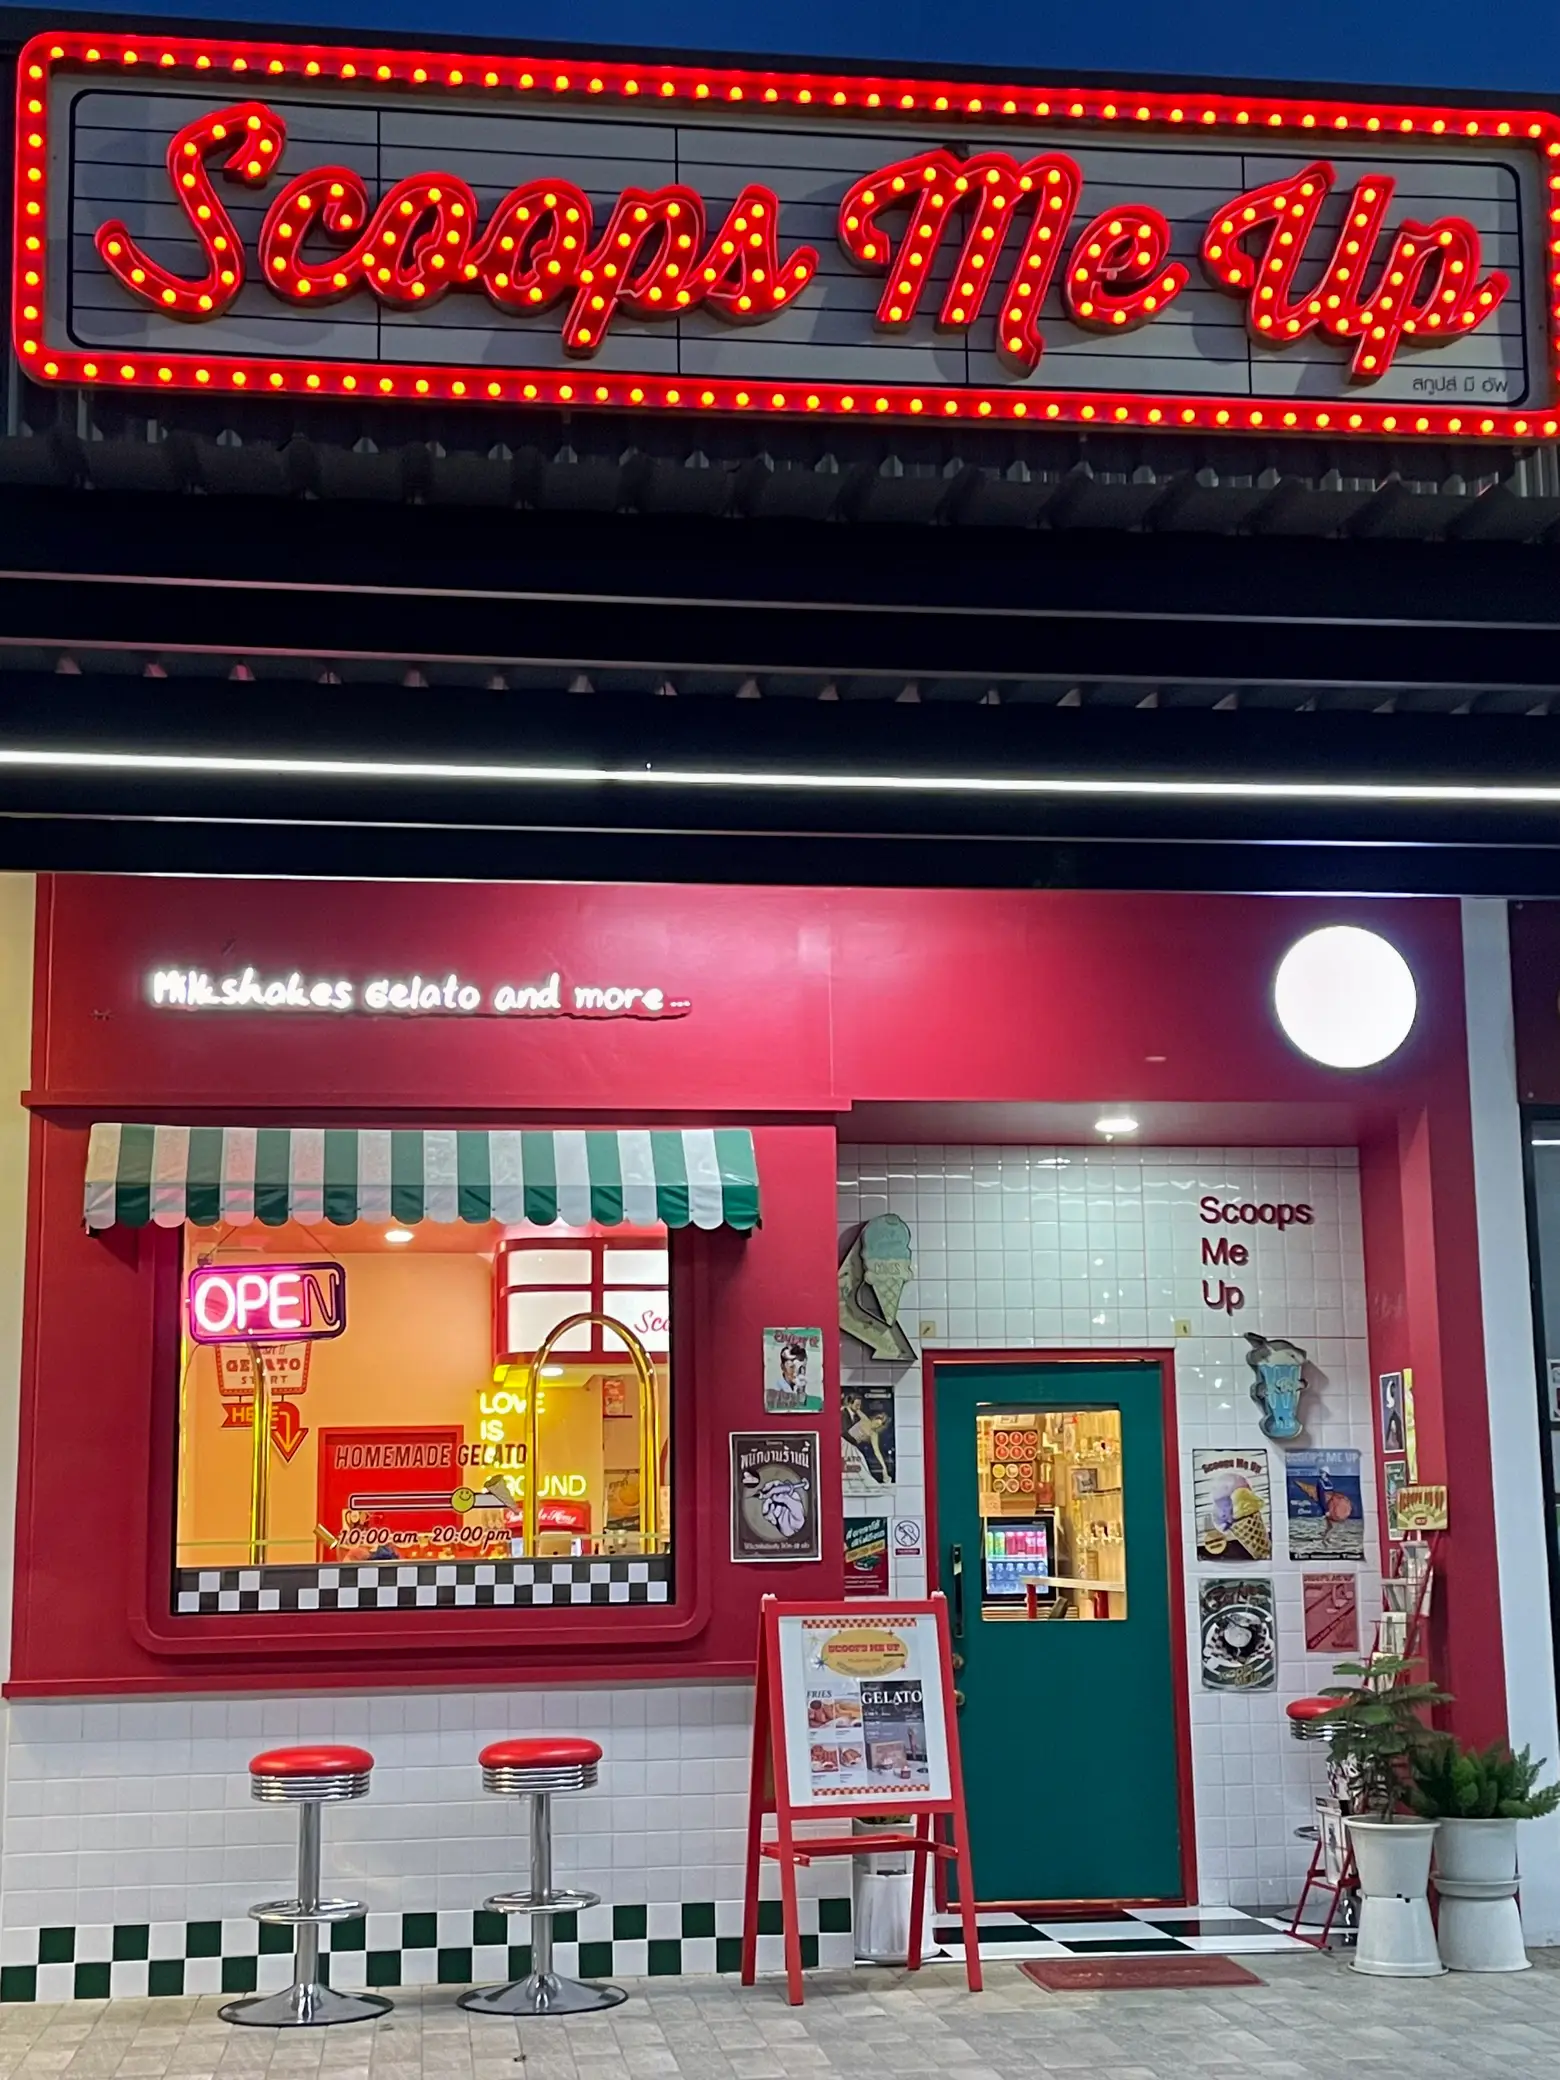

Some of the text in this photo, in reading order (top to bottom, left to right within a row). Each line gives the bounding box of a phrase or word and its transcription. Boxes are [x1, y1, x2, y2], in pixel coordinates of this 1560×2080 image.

[93, 102, 1511, 386] Scoops Me Up
[153, 967, 353, 1010] Milkshakes
[494, 972, 561, 1011] and
[1200, 1196, 1314, 1231] Scoops
[1202, 1237, 1249, 1266] Me
[194, 1272, 340, 1333] OPEN
[1202, 1279, 1245, 1316] Up
[226, 1358, 301, 1372] GEATO
[241, 1375, 288, 1385] STRT
[231, 1406, 280, 1423] HEE
[479, 1391, 546, 1415] LOVE
[480, 1418, 505, 1442] IS
[336, 1443, 528, 1469] HOMEMADE GELATO
[339, 1528, 389, 1545] 10:00
[392, 1531, 419, 1544] am
[432, 1526, 483, 1543] 20:00
[482, 1528, 512, 1550] pm
[806, 1689, 923, 1705] FRIES GELATO
